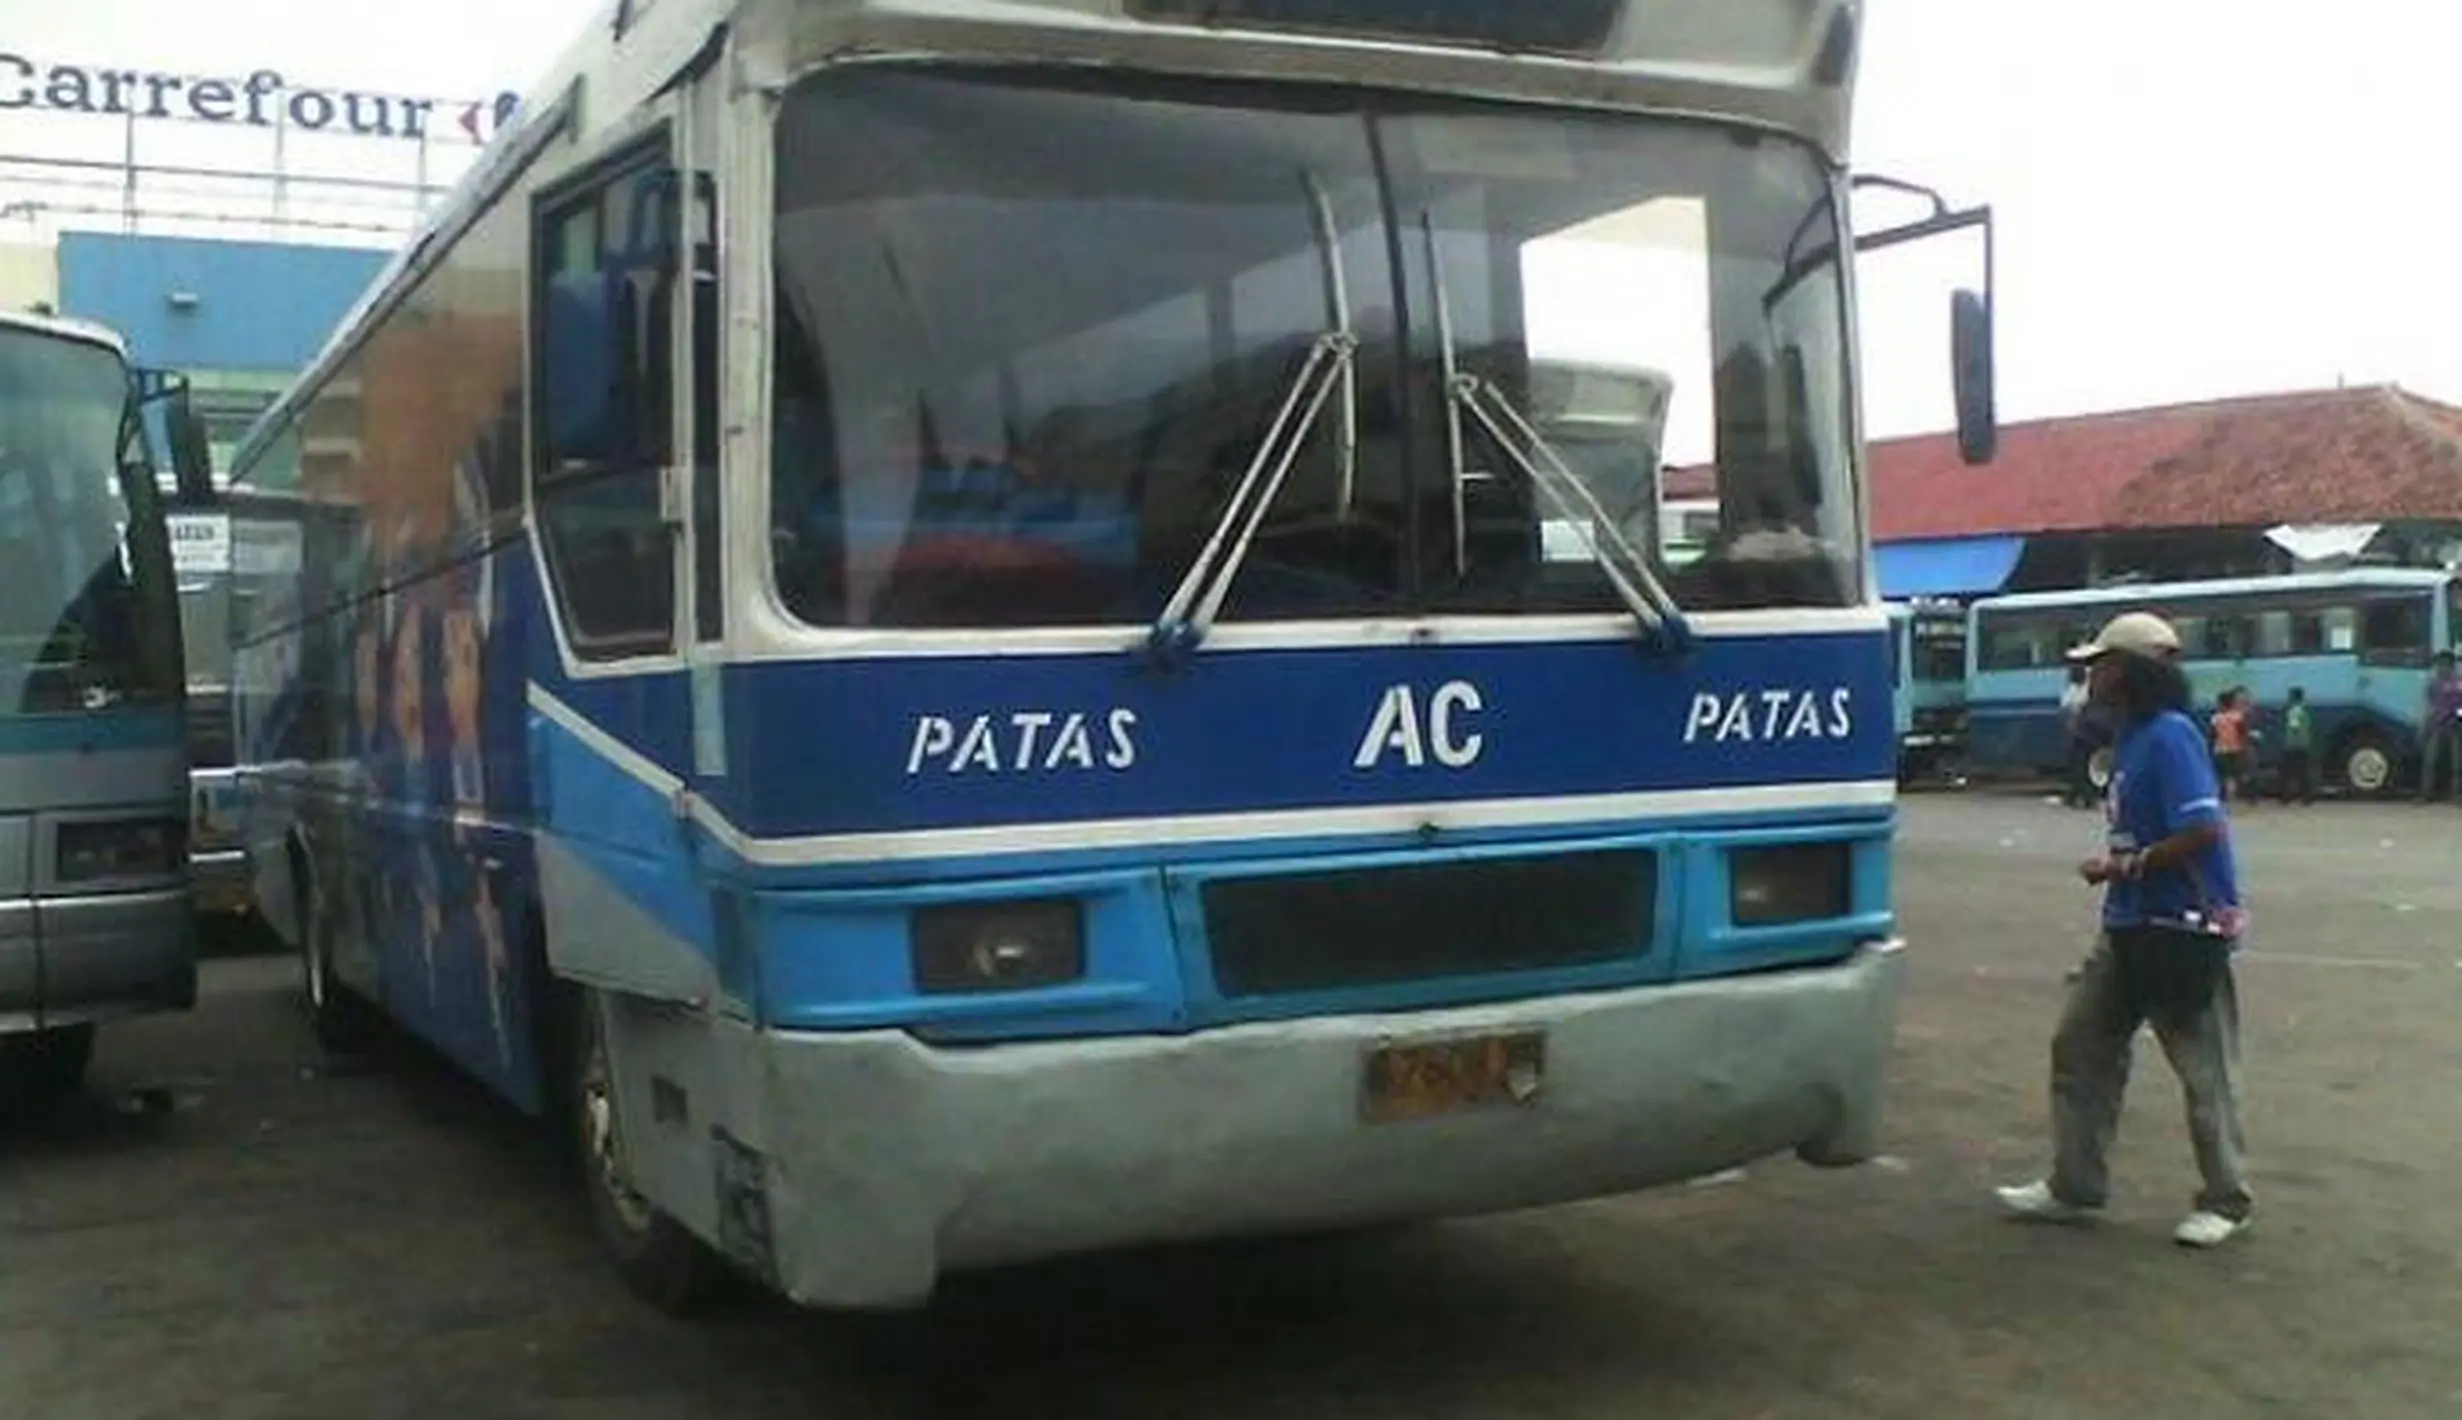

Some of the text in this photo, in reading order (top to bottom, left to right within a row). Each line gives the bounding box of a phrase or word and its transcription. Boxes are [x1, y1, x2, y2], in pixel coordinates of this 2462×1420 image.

[0, 54, 432, 138] Carrefour
[907, 681, 1850, 774] PATAS AC PATAS
